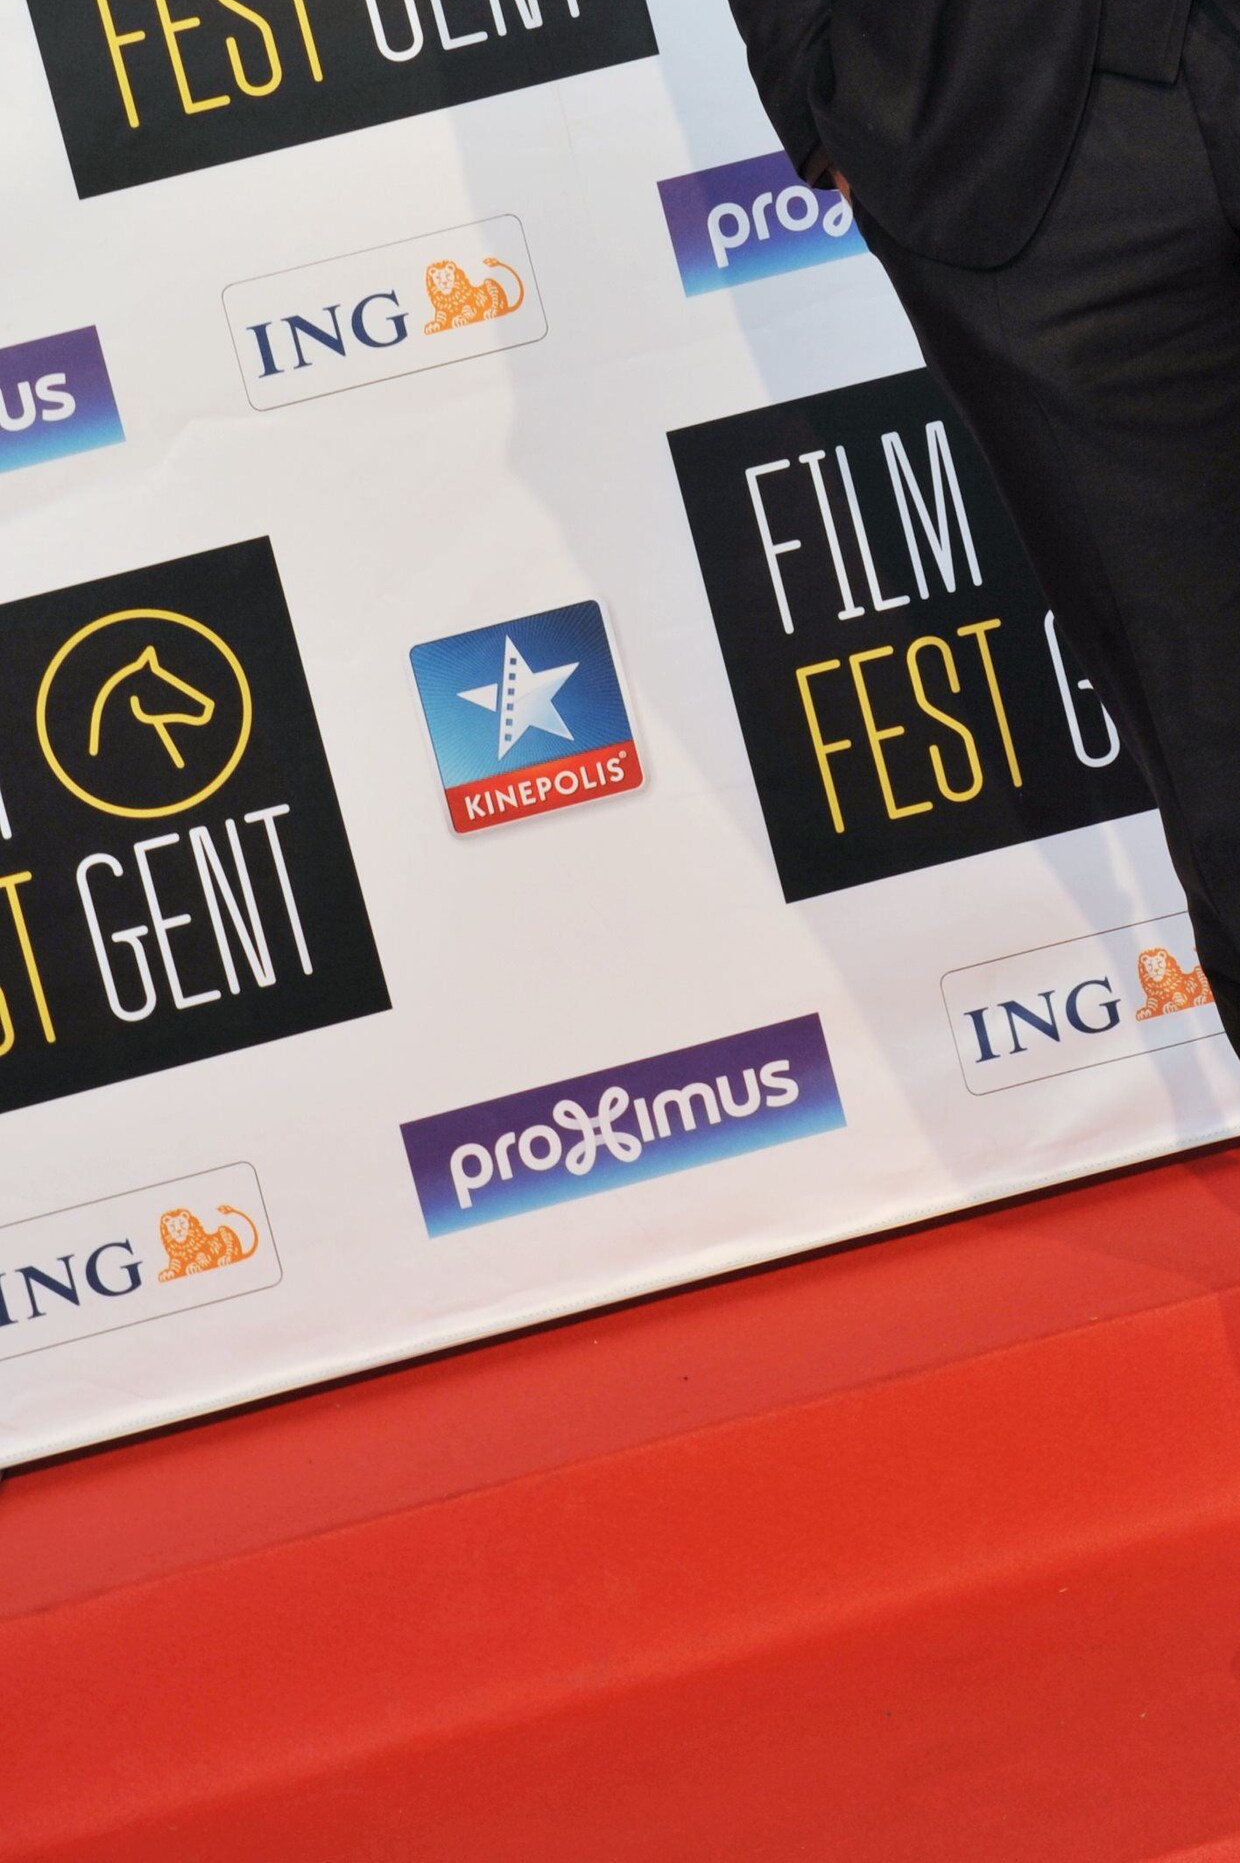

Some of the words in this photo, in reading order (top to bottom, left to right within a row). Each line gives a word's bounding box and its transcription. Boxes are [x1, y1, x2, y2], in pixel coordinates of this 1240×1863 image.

[245, 289, 410, 378] ING
[746, 421, 982, 633] FILM
[796, 619, 1022, 833] FEST
[77, 804, 312, 1021] GENT
[962, 976, 1122, 1065] ING
[451, 1060, 799, 1207] proximus
